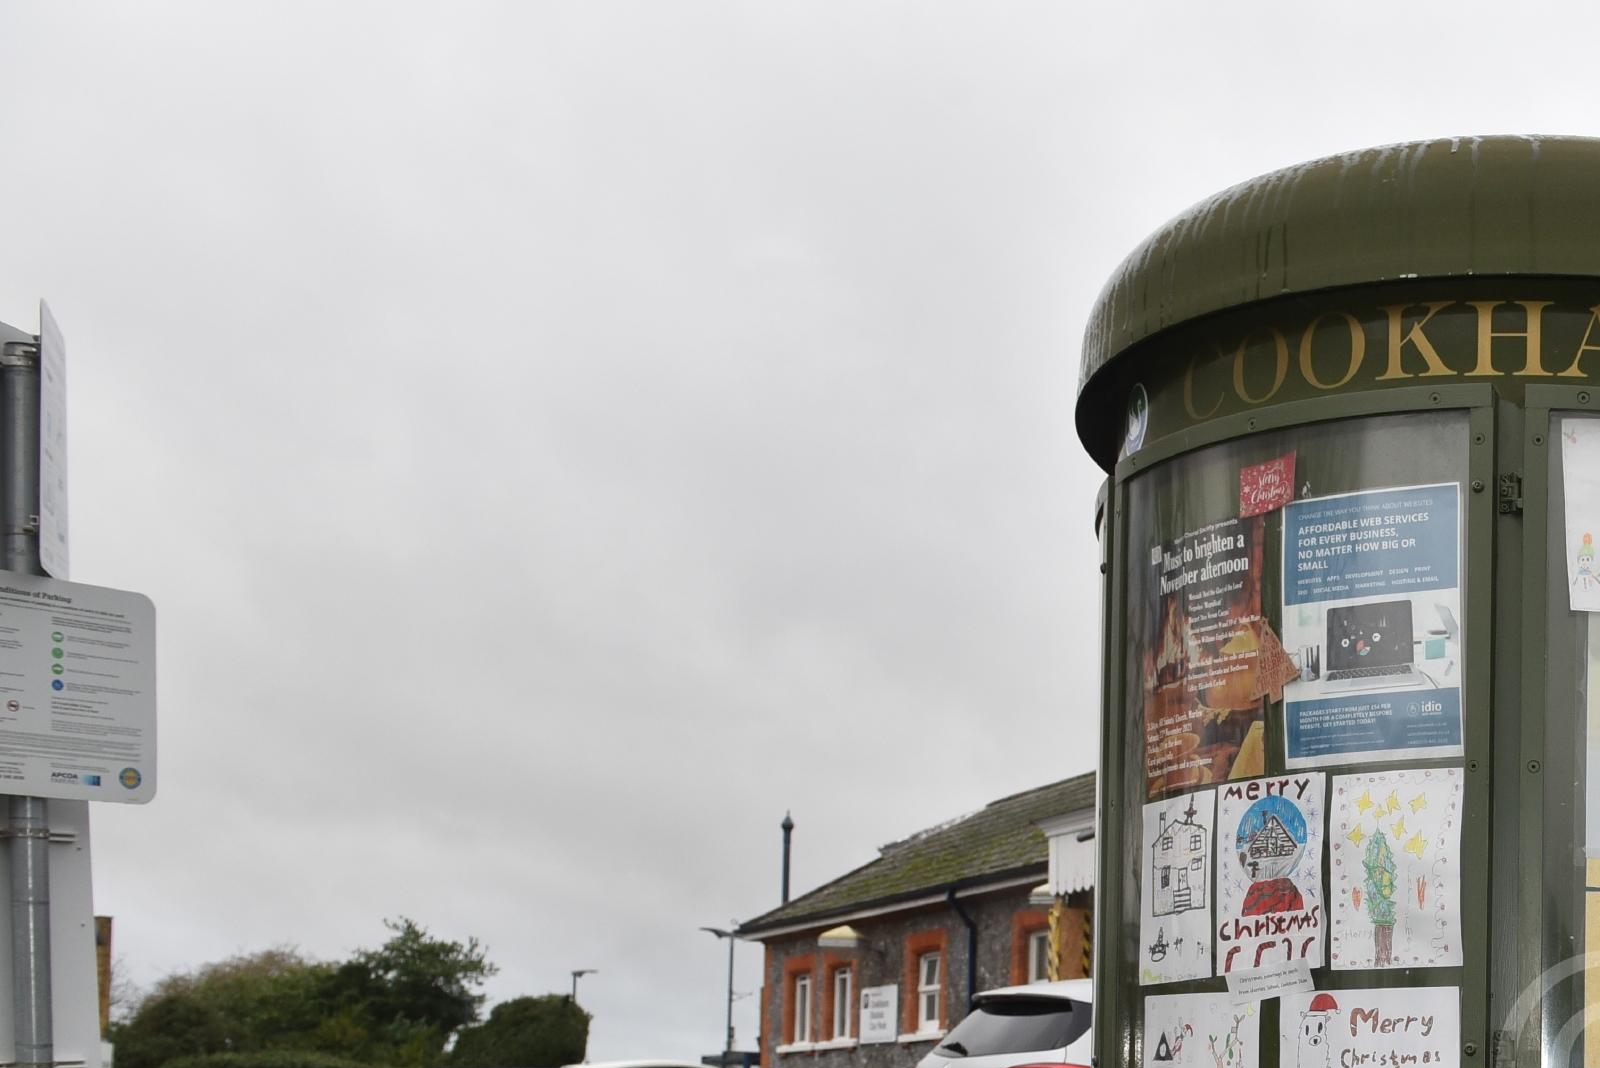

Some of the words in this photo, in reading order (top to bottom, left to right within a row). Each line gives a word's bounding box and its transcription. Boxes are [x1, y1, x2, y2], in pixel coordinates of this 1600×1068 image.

[1299, 520, 1358, 534] AFFORDABLE
[1360, 517, 1382, 527] WEB
[1384, 513, 1429, 524] SERVICES
[1183, 547, 1193, 561] to
[1194, 533, 1234, 560] brighten
[1236, 533, 1245, 548] a
[1299, 537, 1317, 547] FOR
[1319, 534, 1347, 544] EVERY
[1299, 550, 1313, 559] NO
[1316, 546, 1352, 557] MATTER
[1356, 542, 1379, 552] HOW
[1382, 540, 1398, 549] BIG
[1402, 538, 1416, 548] OR
[1298, 561, 1328, 571] SMALL
[1160, 568, 1198, 596] November
[1200, 557, 1249, 581] afternoon
[42, 592, 72, 604] Parking
[1421, 701, 1442, 712] idio
[1350, 1007, 1434, 1036] Merry
[1340, 1048, 1440, 1068] Christmas
